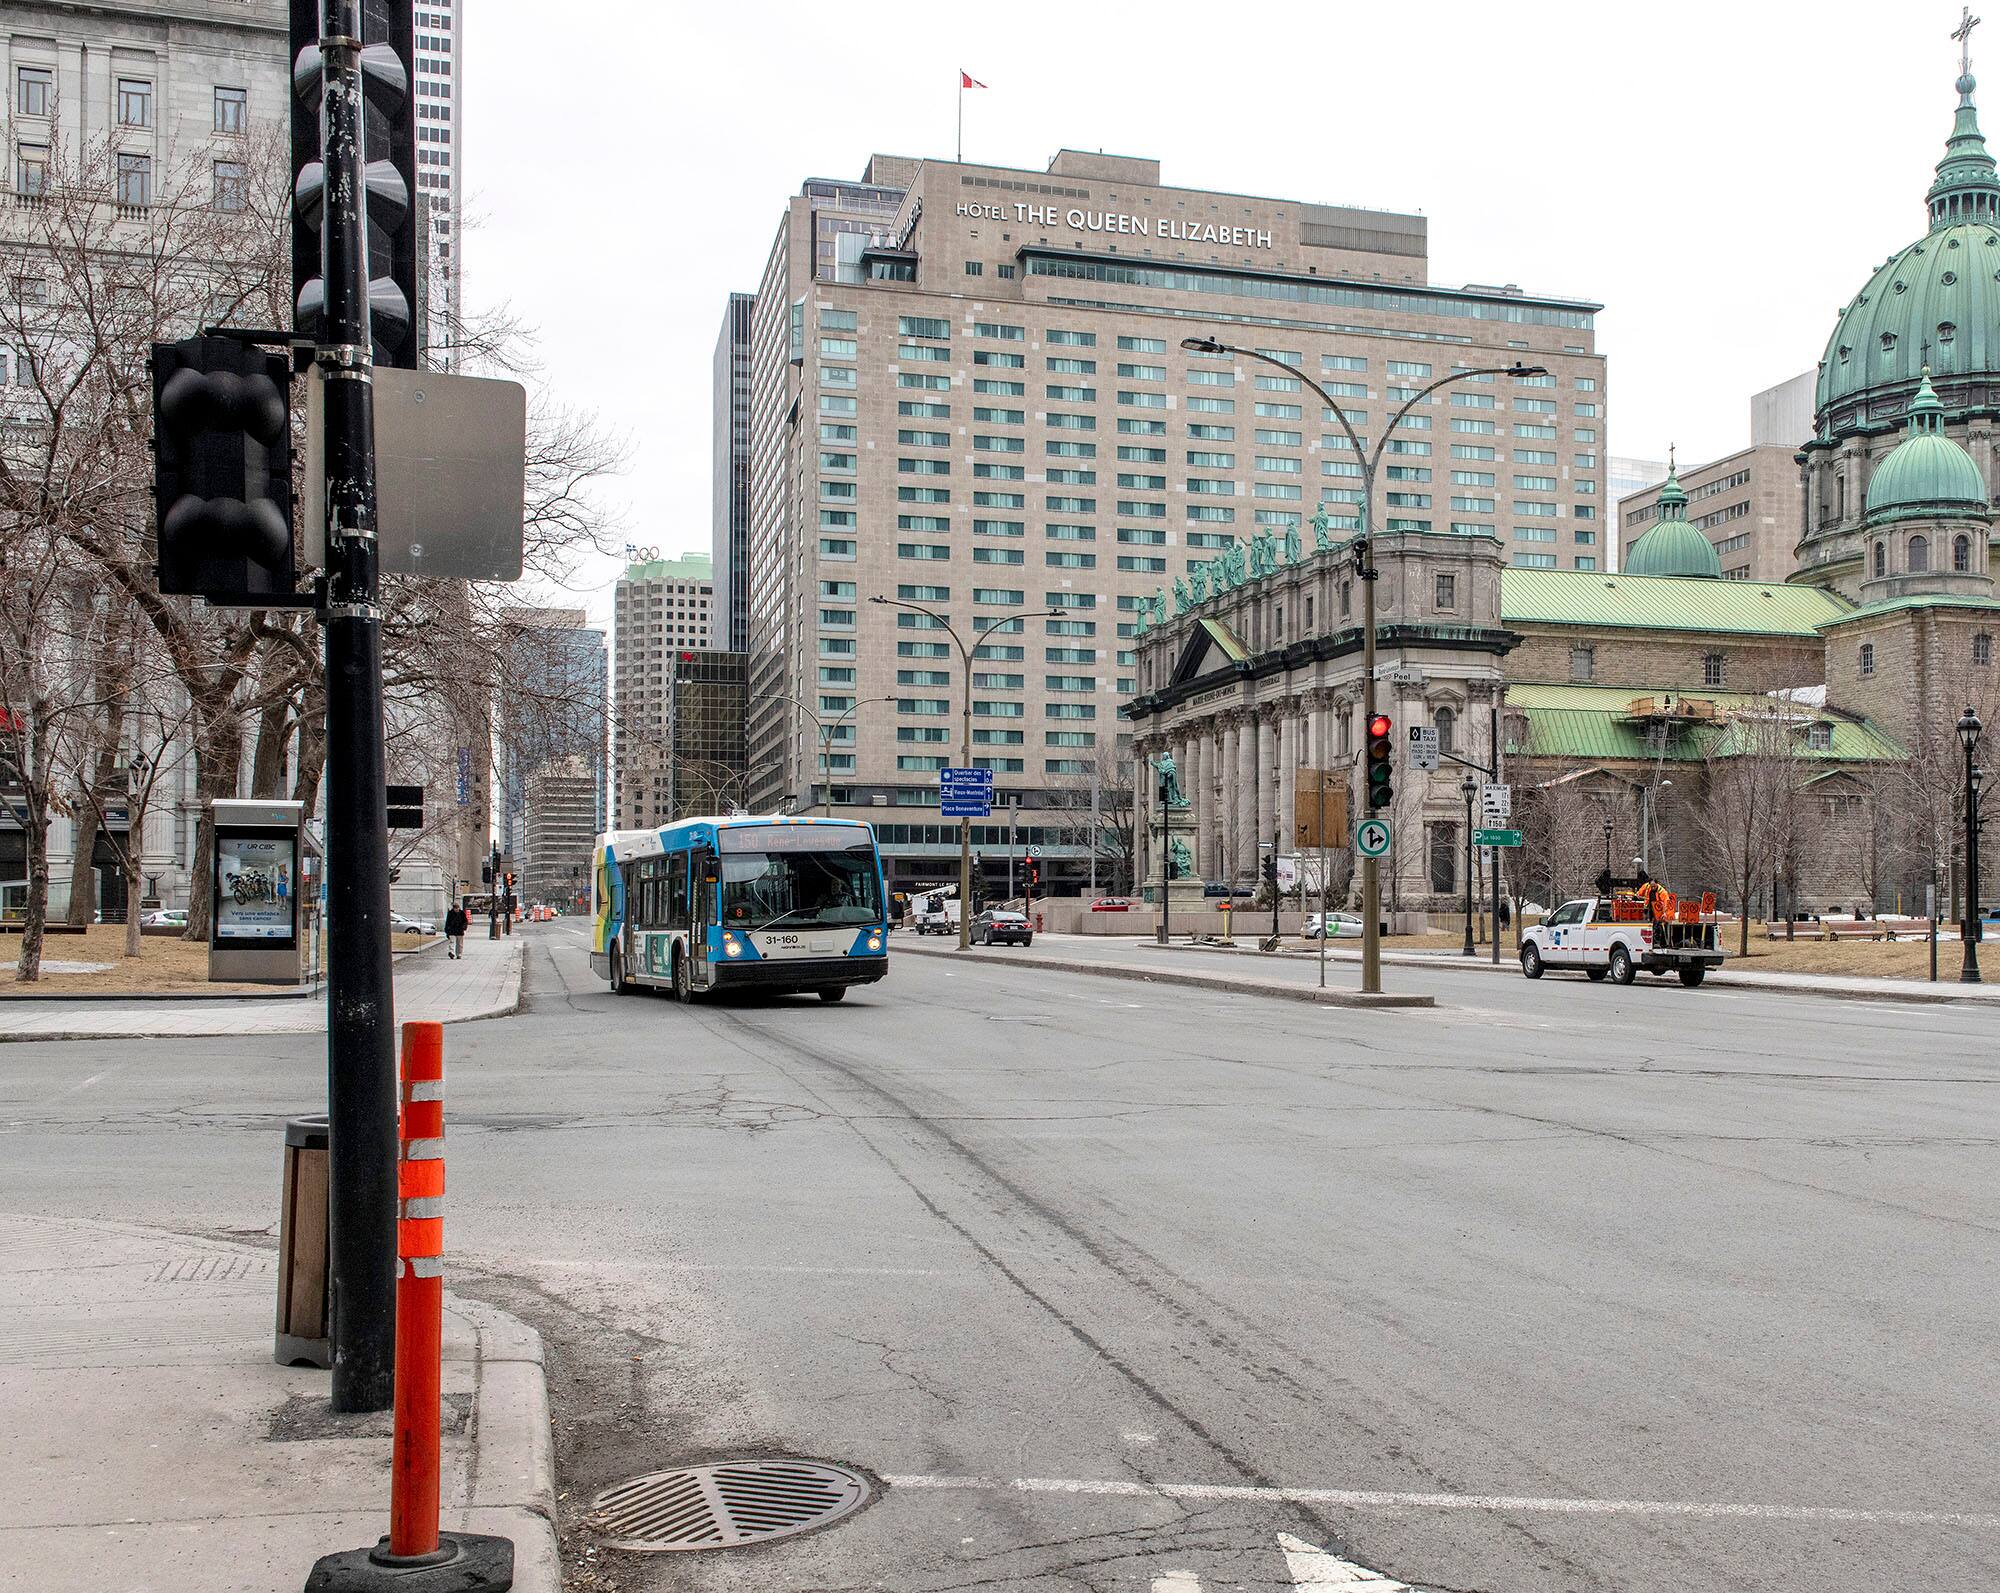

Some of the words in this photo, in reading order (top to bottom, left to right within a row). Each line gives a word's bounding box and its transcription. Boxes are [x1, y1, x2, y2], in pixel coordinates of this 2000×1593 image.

[956, 200, 1008, 221] HÔTEL
[1013, 203, 1058, 226] THE
[1065, 208, 1148, 236] QUEEN
[1156, 218, 1273, 249] ELIZABETH
[1393, 672, 1411, 681] Peel
[765, 935, 798, 945] 31-160
